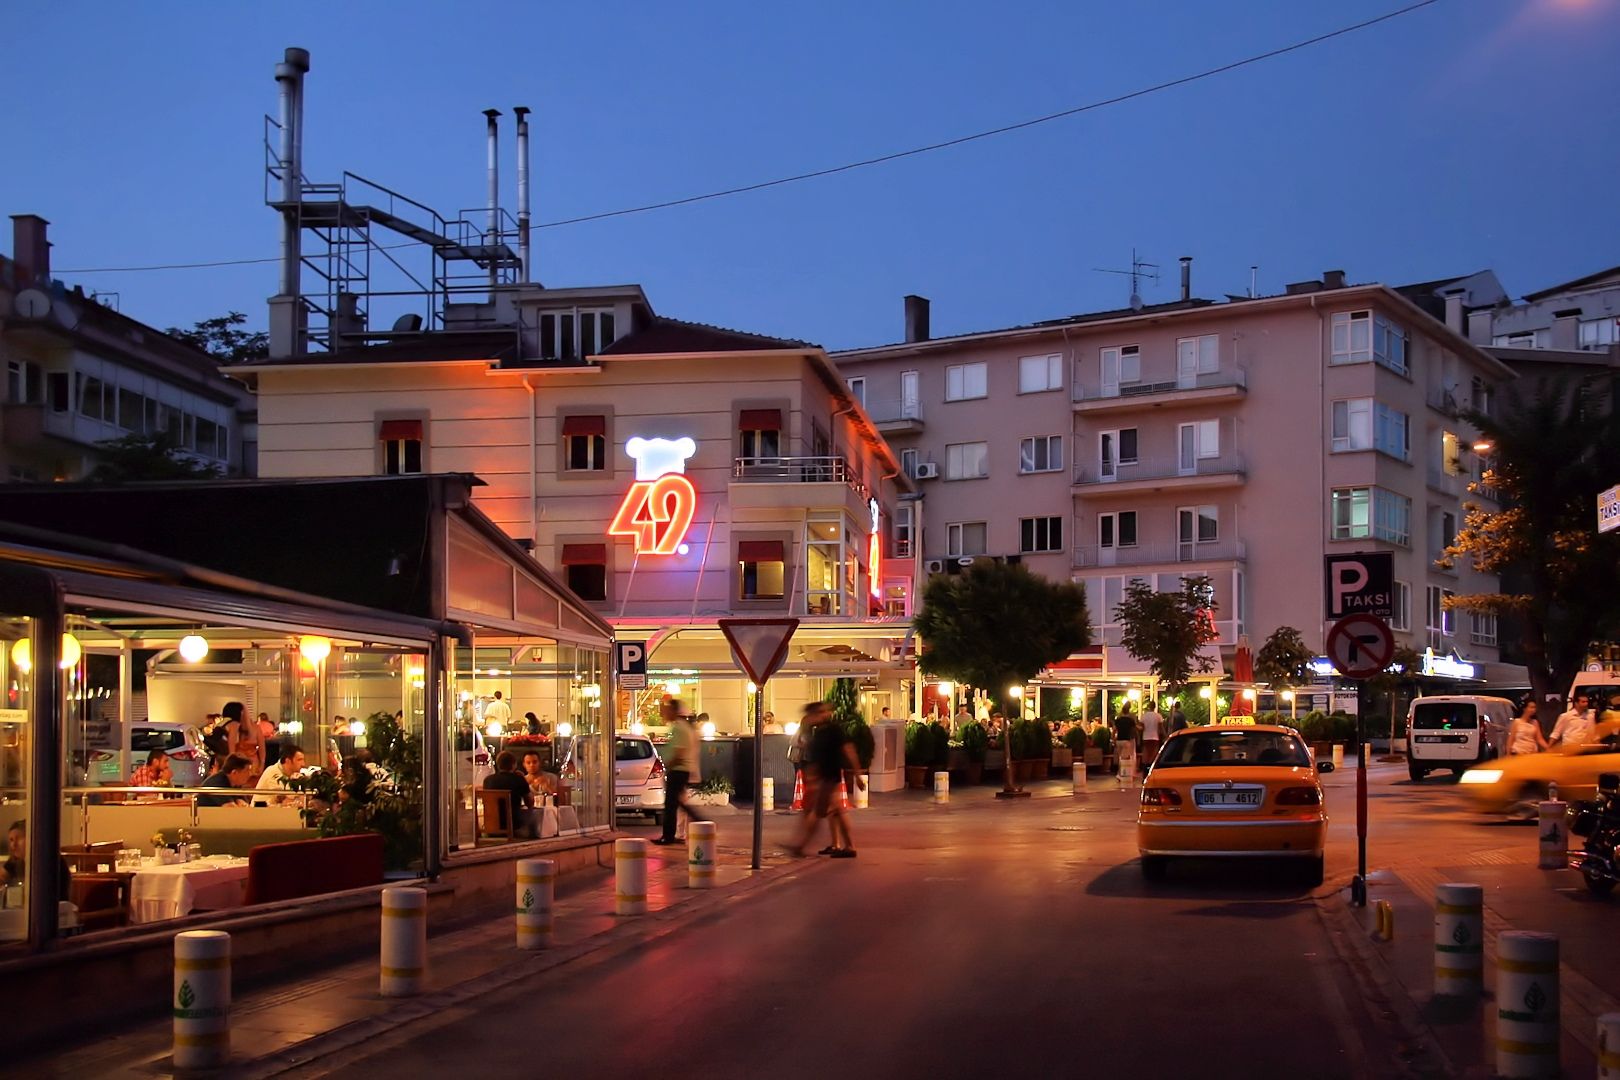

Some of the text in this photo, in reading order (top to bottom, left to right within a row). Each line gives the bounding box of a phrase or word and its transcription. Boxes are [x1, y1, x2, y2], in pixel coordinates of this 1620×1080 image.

[1331, 560, 1369, 614] P
[621, 644, 643, 671] P
[1204, 793, 1215, 803] 06
[1221, 793, 1227, 803] T
